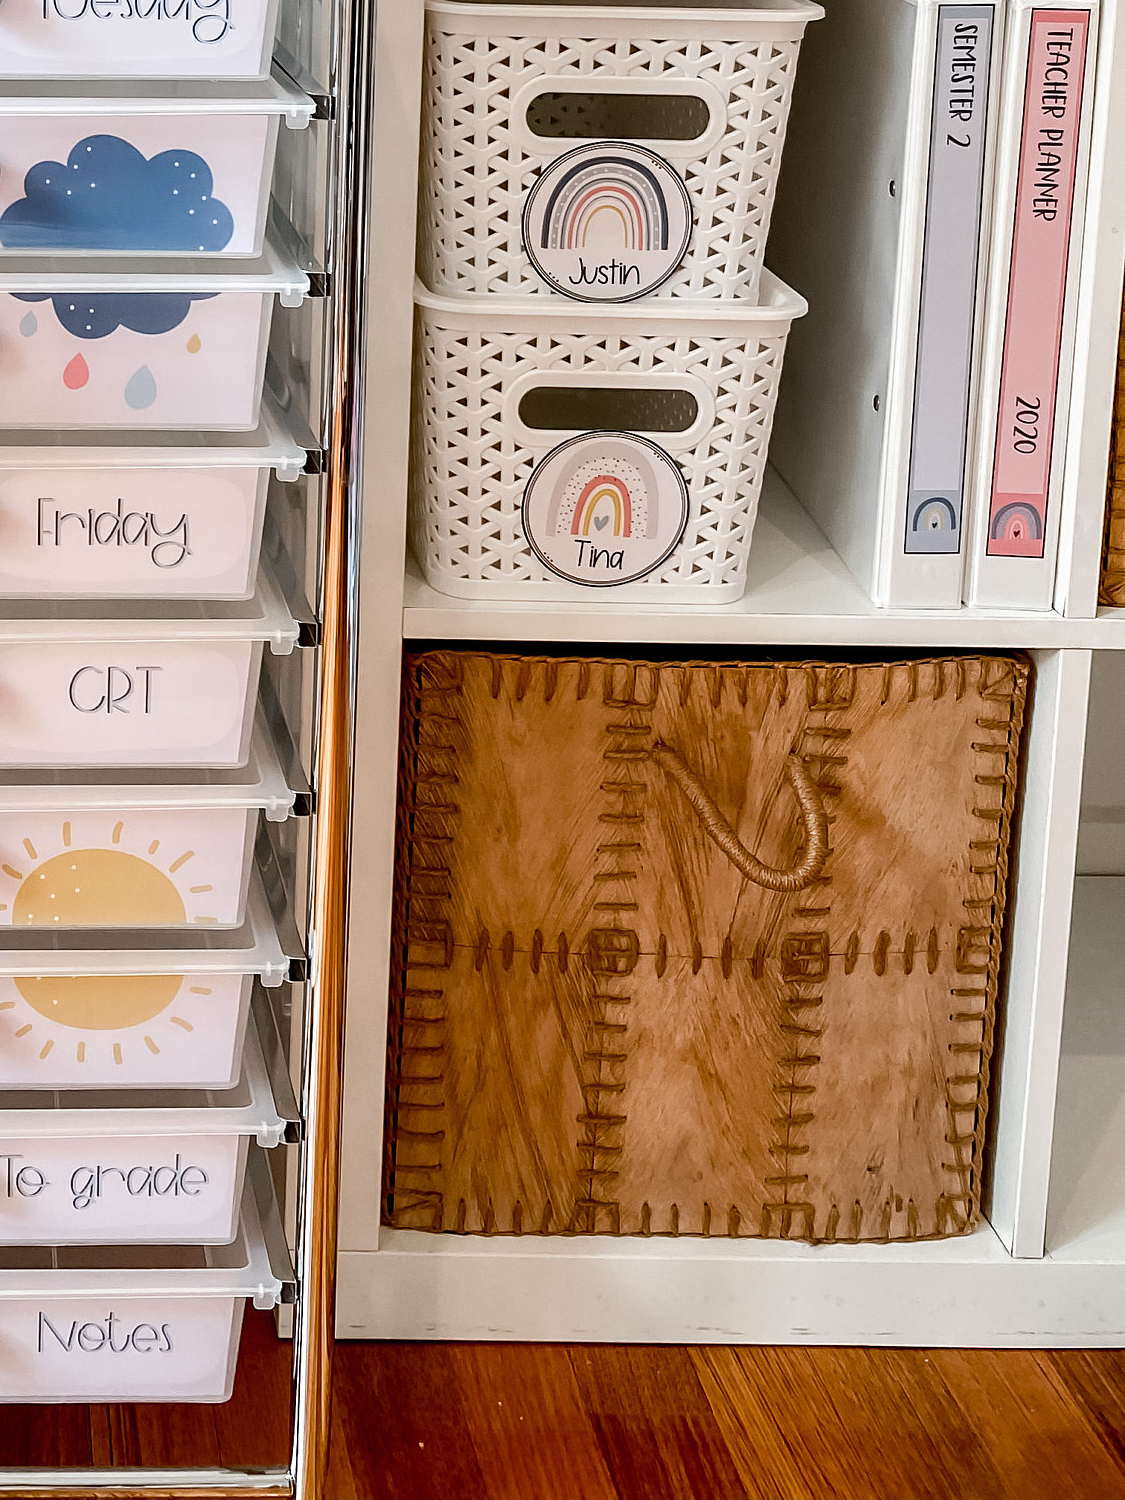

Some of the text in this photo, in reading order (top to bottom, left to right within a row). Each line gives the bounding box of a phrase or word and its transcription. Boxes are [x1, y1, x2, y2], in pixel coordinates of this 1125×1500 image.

[946, 23, 979, 148] SEMESTER 2
[1032, 27, 1074, 222] TEACHER PLANNER
[568, 257, 640, 285] Justin
[1013, 396, 1041, 454] 2020
[36, 497, 194, 569] Friday
[574, 540, 625, 571] Tina
[69, 665, 163, 715] CRT
[70, 1153, 209, 1211] grade
[37, 1311, 173, 1354] Notes
